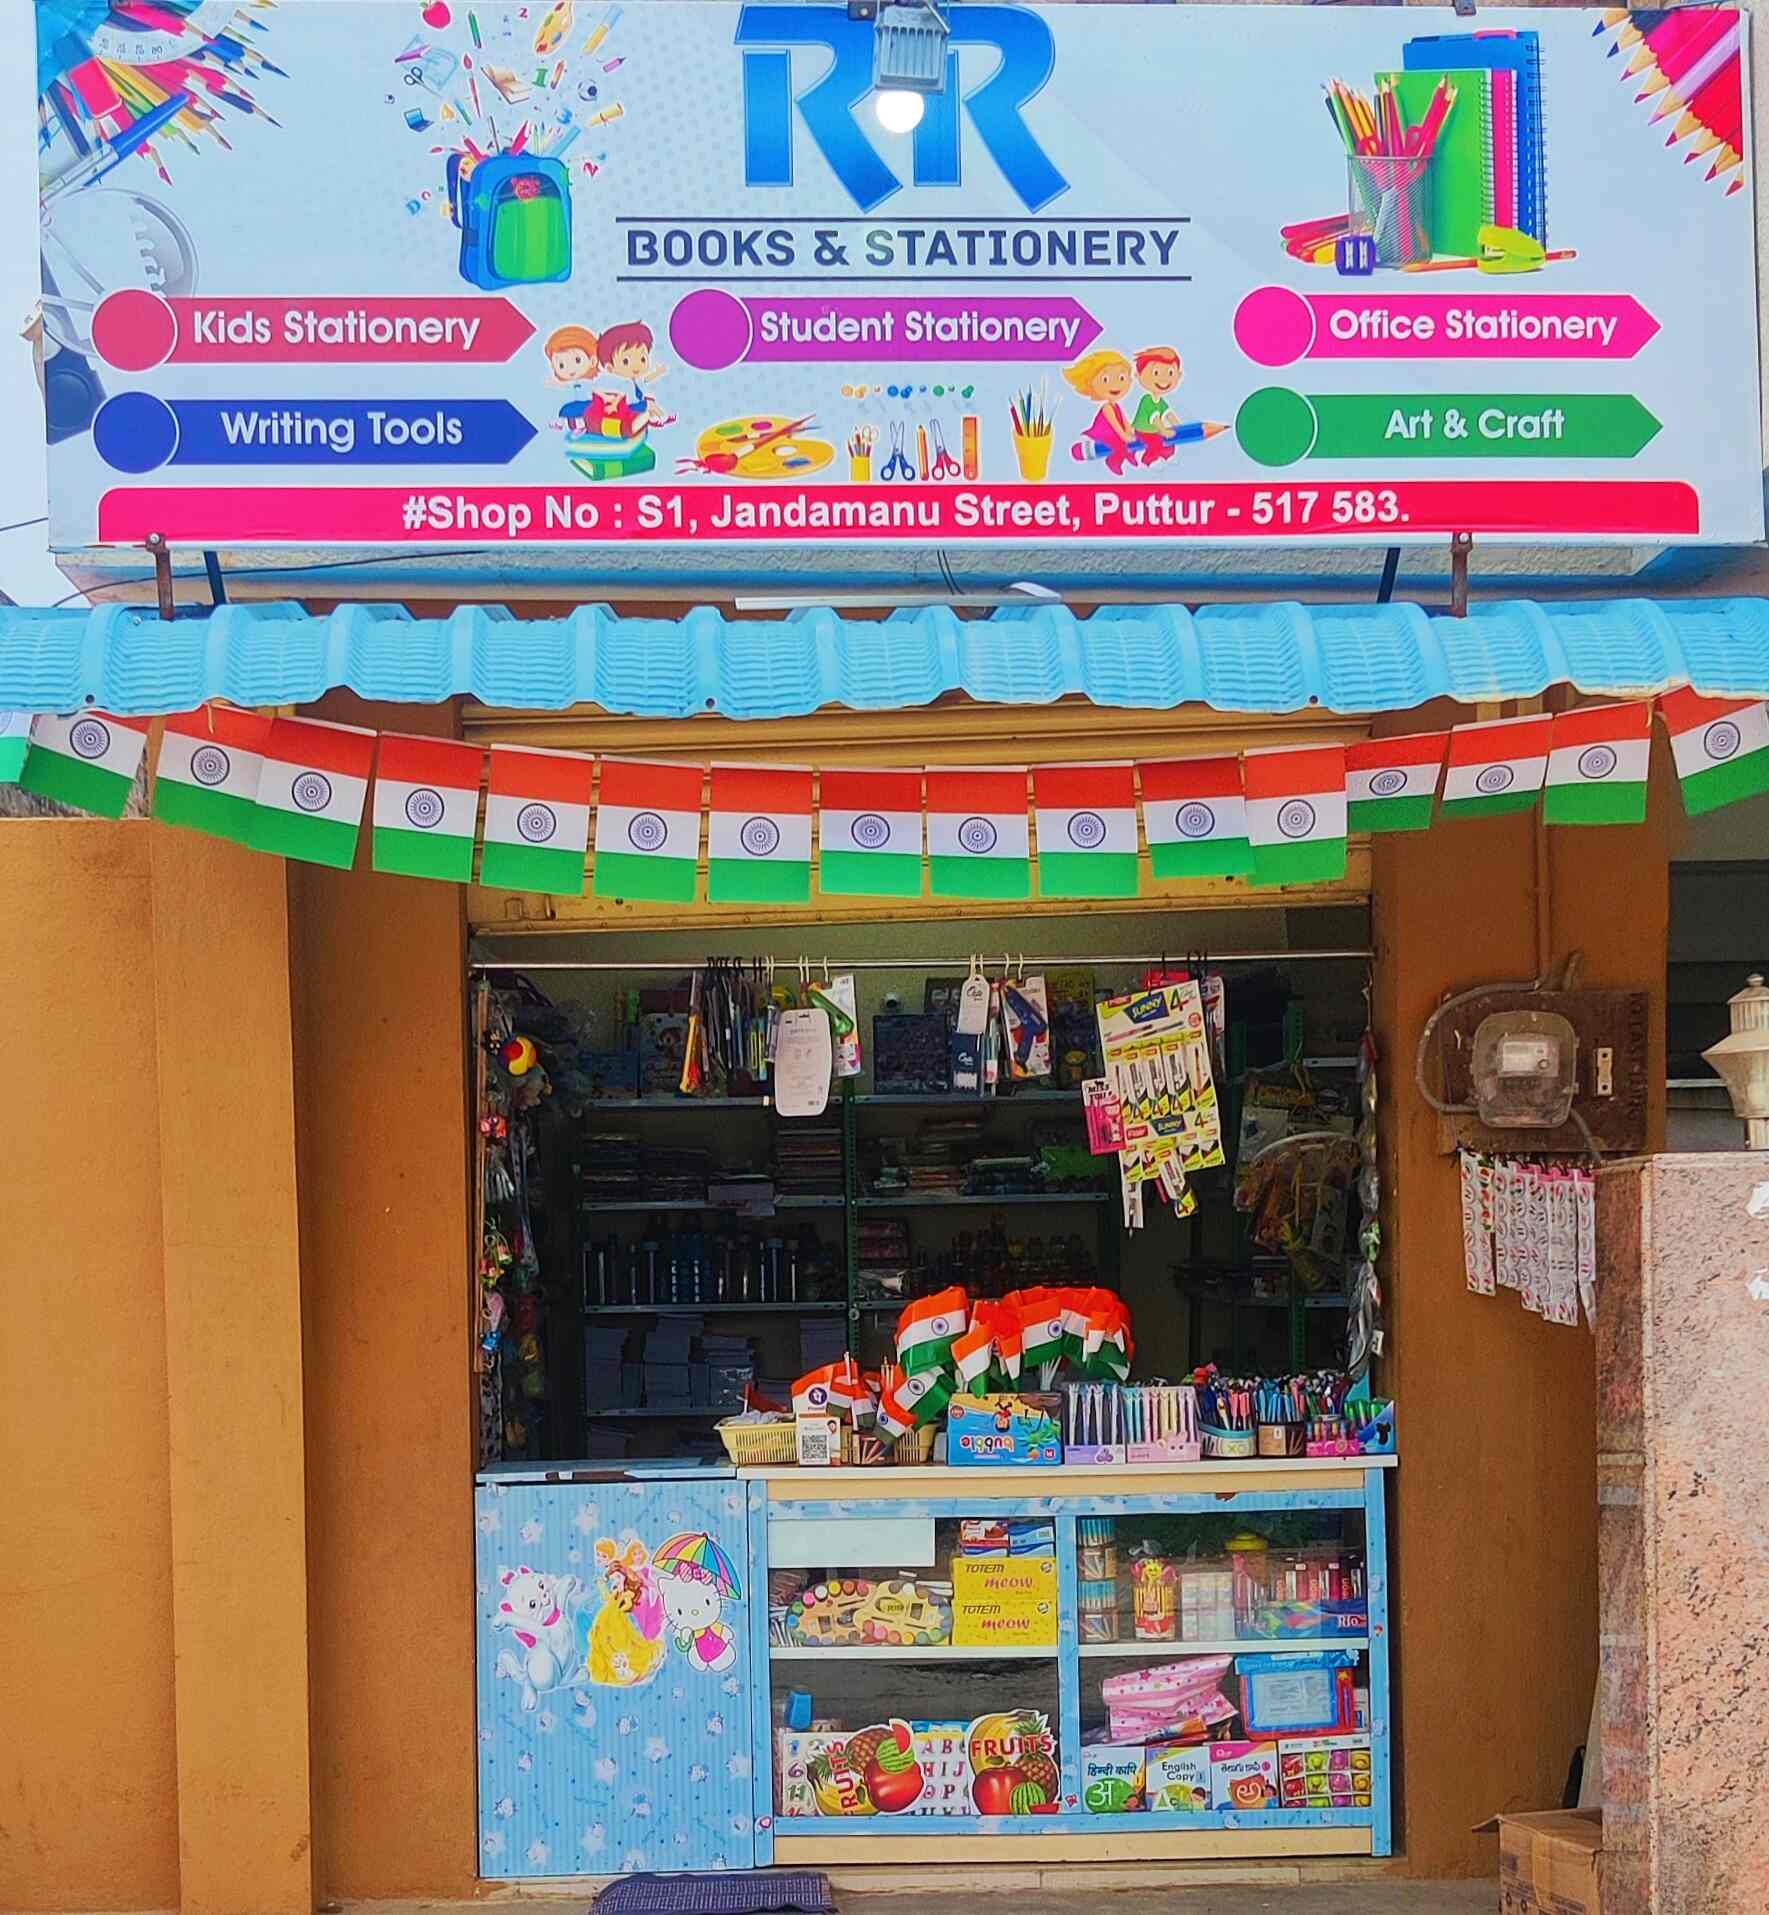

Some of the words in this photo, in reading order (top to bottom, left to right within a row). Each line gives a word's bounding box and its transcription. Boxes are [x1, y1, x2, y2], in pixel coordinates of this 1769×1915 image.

[735, 3, 1072, 214] RR
[627, 229, 795, 266] BOOKS
[814, 229, 850, 266] &
[865, 229, 1179, 267] STATIONERY
[194, 311, 271, 344] Kids
[284, 311, 481, 350] Stationery
[761, 311, 894, 343] Student
[905, 311, 1081, 347] Stationery
[1330, 309, 1435, 340] Office
[1446, 309, 1617, 346] Stationery
[221, 412, 354, 452] Writing
[367, 412, 462, 444] Tools
[1385, 410, 1433, 439] Art
[1444, 410, 1468, 439] &
[1478, 409, 1565, 439] Craft
[403, 495, 532, 537] #Shop
[545, 495, 599, 529] No
[613, 503, 622, 528] :
[637, 494, 697, 534] S1,
[711, 493, 940, 529] Jandamanu
[967, 493, 1081, 532] Street,
[1095, 491, 1215, 526] Puttur
[1227, 508, 1240, 517] -
[1252, 490, 1318, 525] 517
[1332, 490, 1409, 524] 583.
[965, 1563, 1005, 1574] TOTEM
[962, 1604, 1001, 1615] TOTEM
[970, 1735, 1053, 1758] FRUITS
[826, 1738, 860, 1816] RUITS
[1161, 1761, 1197, 1772] English
[1166, 1771, 1195, 1782] Copy
[1087, 1780, 1115, 1807] अ
